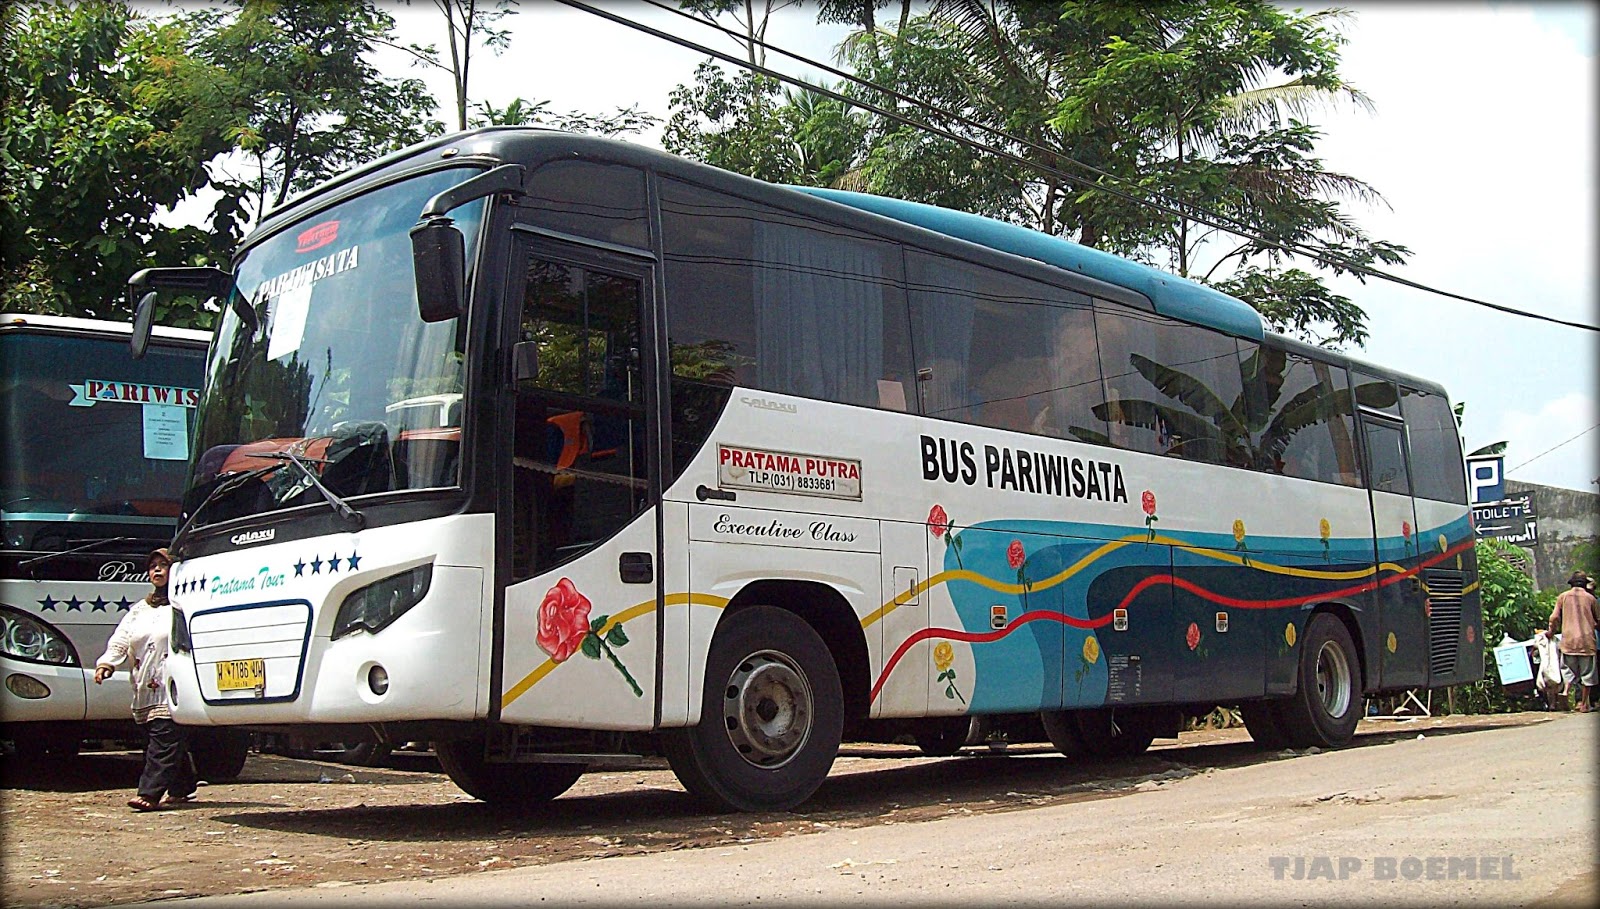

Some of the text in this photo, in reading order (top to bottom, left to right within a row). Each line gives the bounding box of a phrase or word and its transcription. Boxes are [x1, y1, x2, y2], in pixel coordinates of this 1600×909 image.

[255, 245, 359, 306] PARIWISATA
[720, 448, 859, 479] PRATAMA PUTRA
[920, 434, 1128, 504] BUS PARIWISATA
[797, 476, 836, 491] 8833681
[1470, 460, 1499, 502] P
[713, 513, 858, 542] Executive Class
[1473, 506, 1522, 520] TOILET
[210, 566, 285, 599] Pratama Tour
[231, 661, 249, 679] 7186
